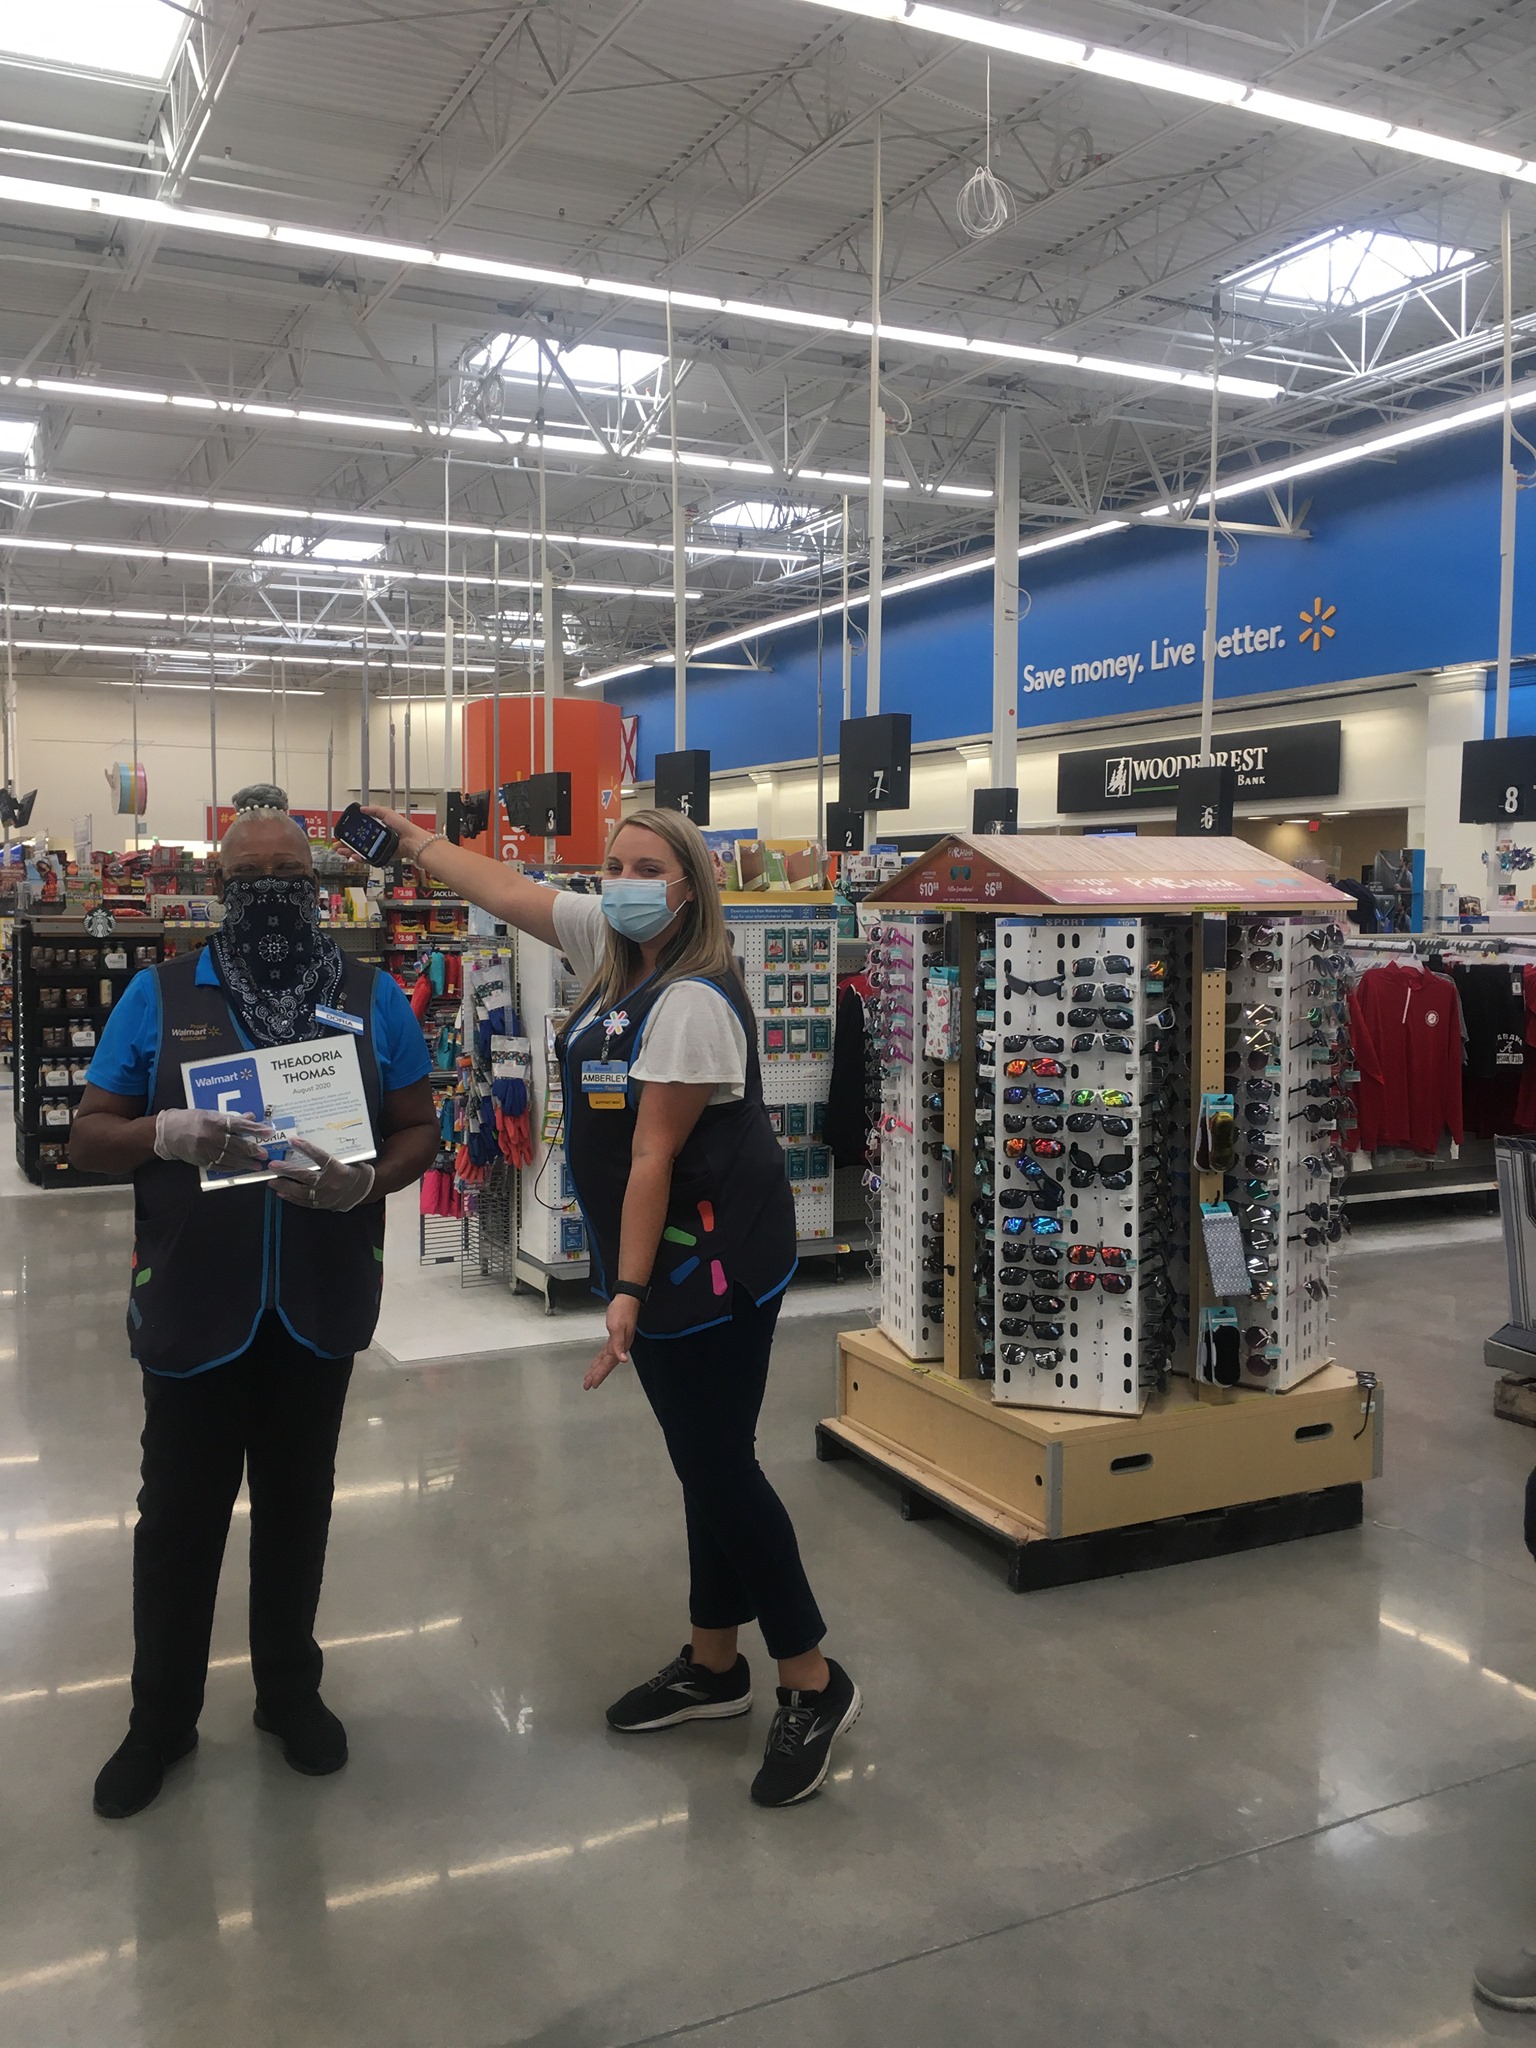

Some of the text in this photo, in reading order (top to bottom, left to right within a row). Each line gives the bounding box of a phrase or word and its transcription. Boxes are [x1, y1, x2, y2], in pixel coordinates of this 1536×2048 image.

[1023, 664, 1066, 693] Save
[1070, 652, 1144, 684] money.
[1151, 637, 1195, 671] Live
[873, 770, 884, 799] 7
[680, 794, 689, 816] 5
[1504, 786, 1519, 813] 8
[547, 809, 555, 830] 3
[1204, 807, 1214, 830] 6
[845, 830, 853, 847] 2
[326, 1014, 354, 1027] DORIA
[171, 1028, 207, 1036] Walmart
[271, 1049, 343, 1071] THEADORIA
[195, 1072, 239, 1088] Walmart
[282, 1065, 336, 1084] THOMAS
[582, 1074, 627, 1083] AMBERLEY
[292, 1081, 332, 1095] August 2020
